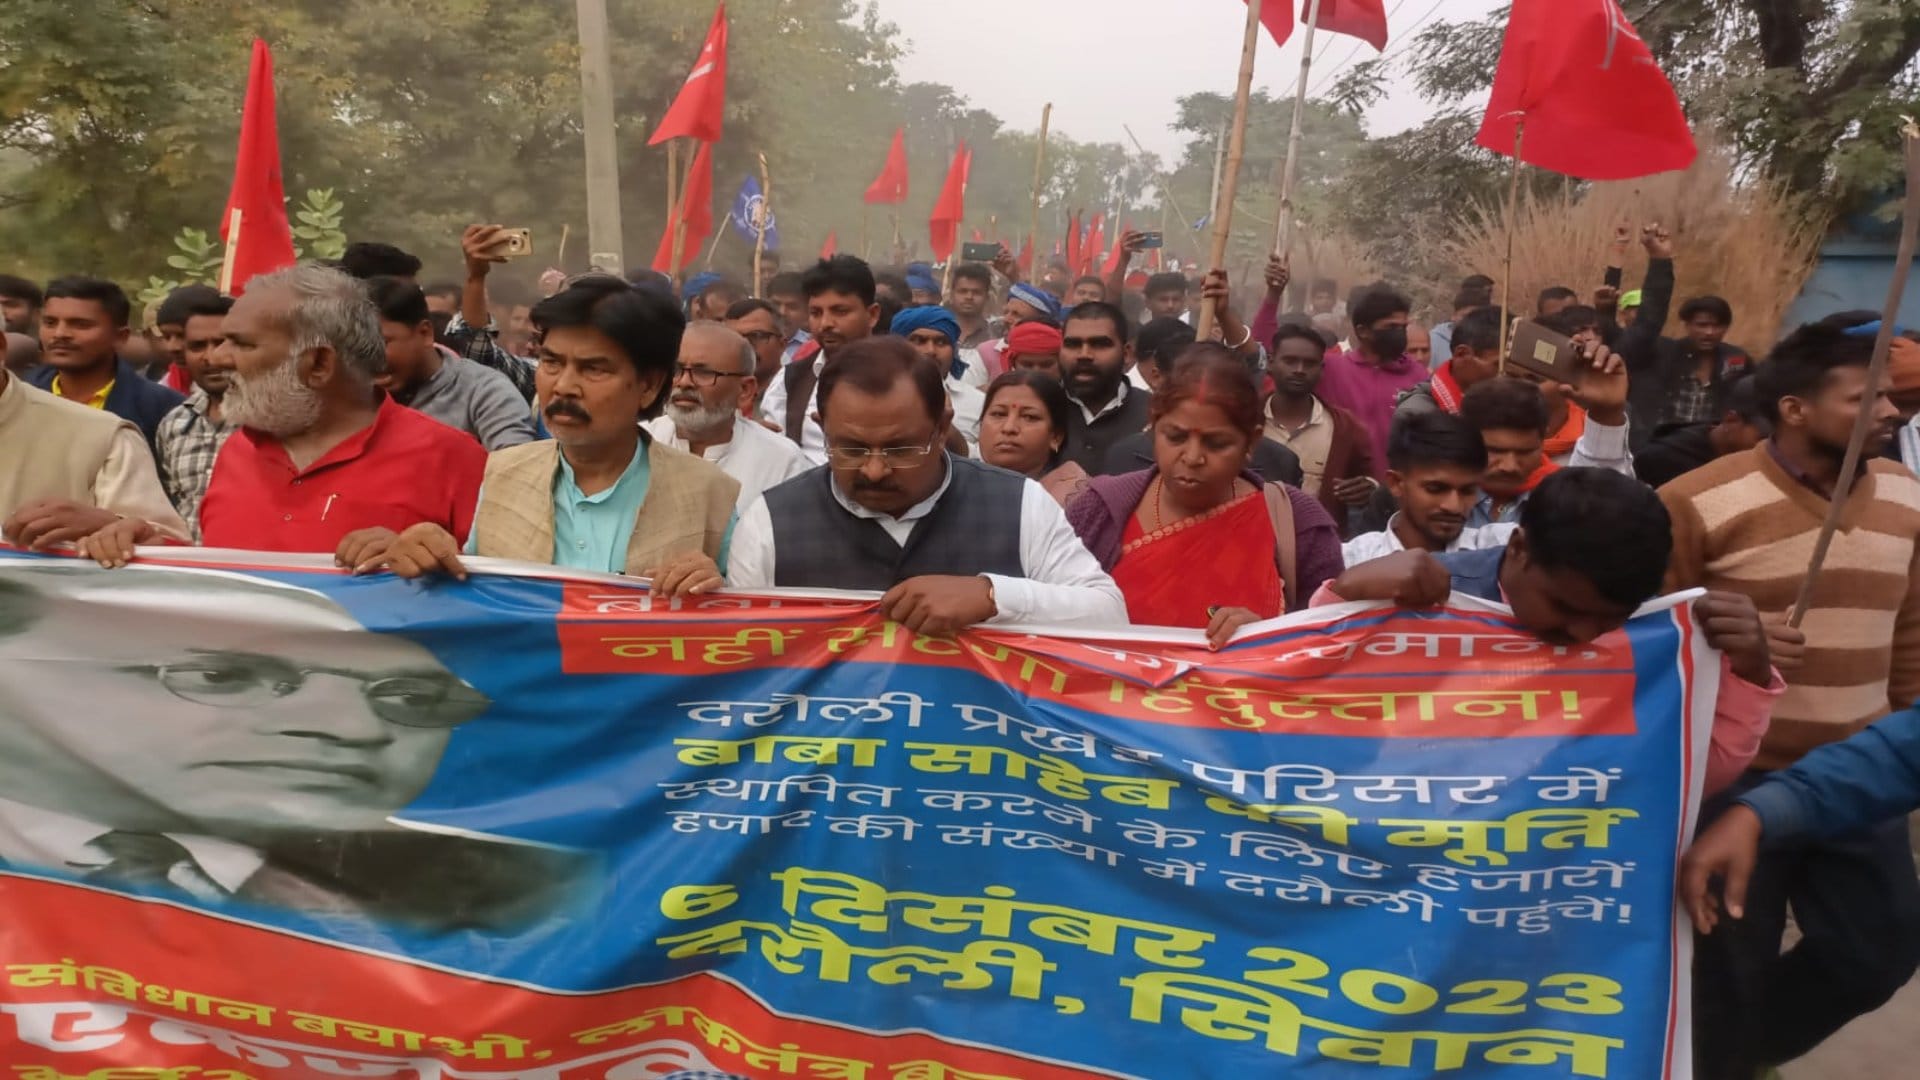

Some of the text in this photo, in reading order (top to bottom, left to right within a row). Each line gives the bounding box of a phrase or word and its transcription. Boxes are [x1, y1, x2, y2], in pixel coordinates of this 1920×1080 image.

[600, 628, 805, 665] नहीं
[673, 735, 887, 767] बाबा
[903, 741, 1181, 811] साहेब
[1378, 807, 1640, 867] मूर्ति
[677, 691, 936, 728] दरौली
[1182, 760, 1506, 804] परिसर
[1528, 767, 1622, 803] में
[657, 774, 1637, 894] स्थापित करने के लिए हजारों
[824, 813, 924, 842] की
[936, 822, 1126, 868] संख्या
[1138, 857, 1207, 887] में
[1219, 869, 1444, 924] दरौली
[660, 866, 1625, 1016] 6 दिसंबर 2023
[5, 957, 277, 1028] संविधान
[287, 1008, 553, 1061] बचाओ,
[571, 1005, 875, 1080] लोकतंत्र
[1120, 970, 1625, 1079] सिवान
